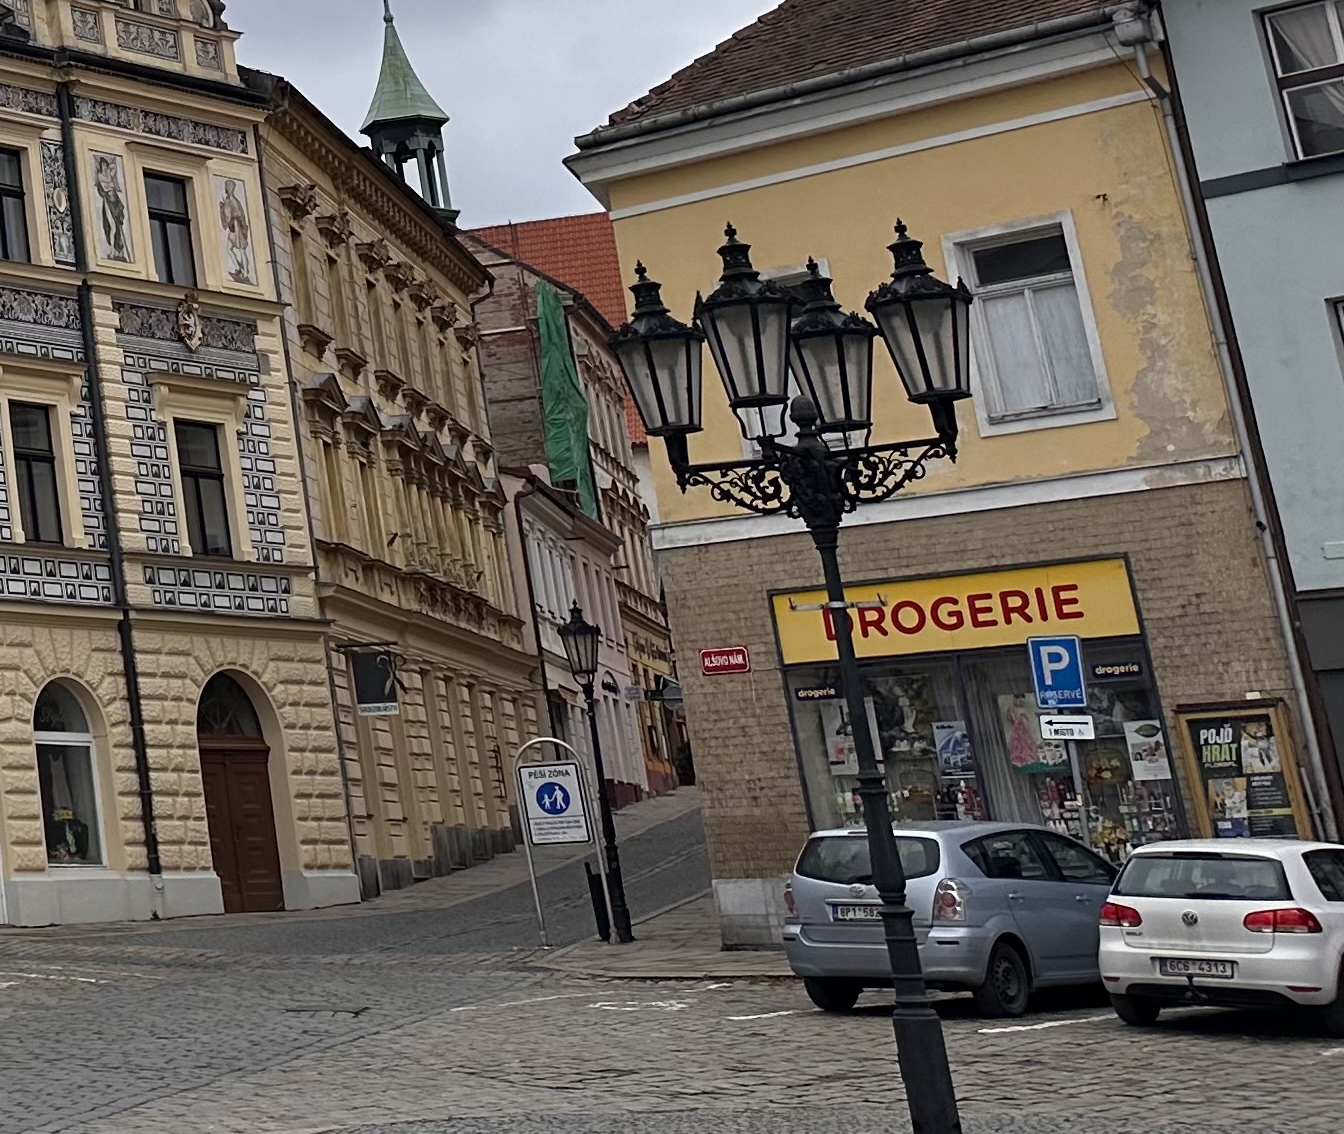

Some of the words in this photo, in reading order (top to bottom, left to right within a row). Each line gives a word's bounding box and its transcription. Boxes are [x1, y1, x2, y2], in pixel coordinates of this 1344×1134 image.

[1040, 646, 1070, 685] P
[1095, 663, 1139, 675] drogerie
[798, 687, 836, 699] drogerie
[1169, 961, 1190, 972] 6C6
[1198, 962, 1227, 974] 4313
